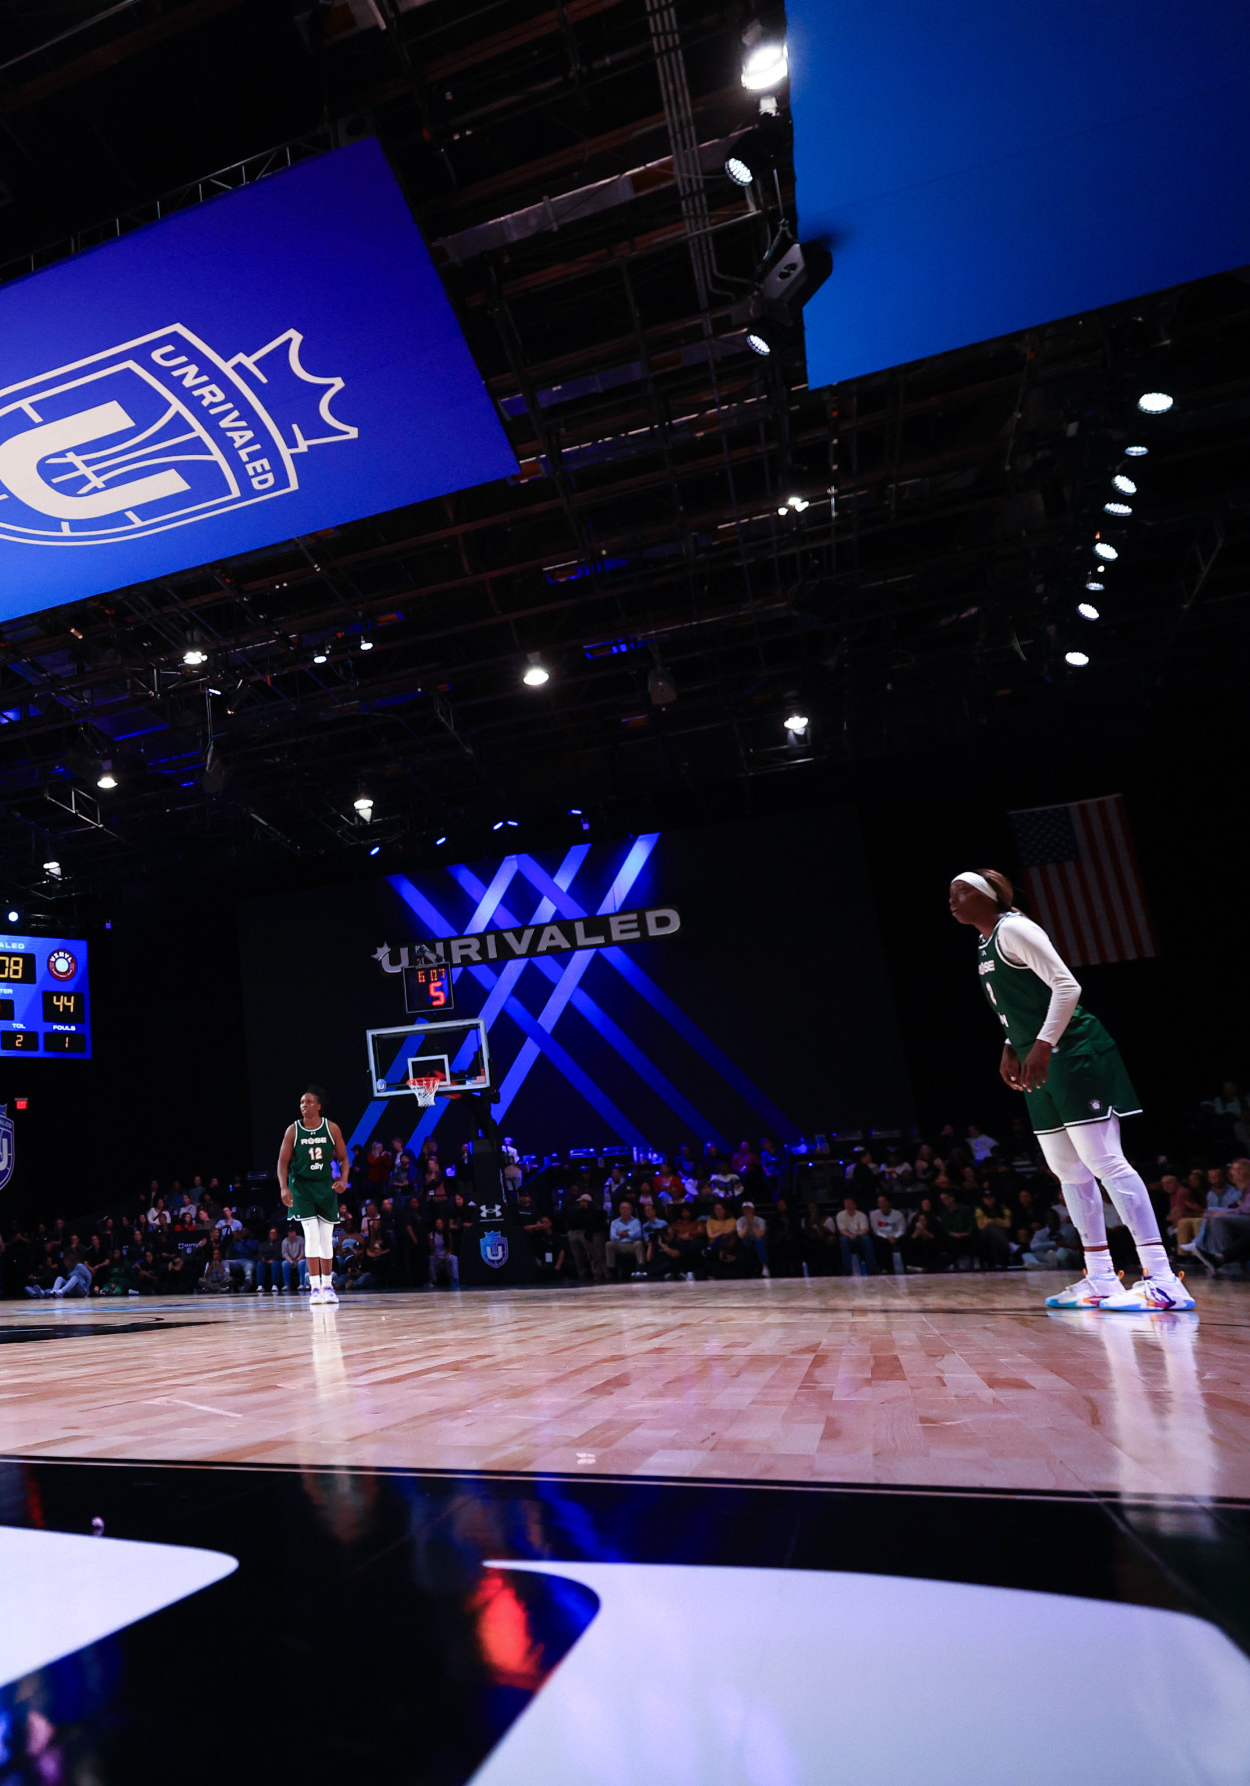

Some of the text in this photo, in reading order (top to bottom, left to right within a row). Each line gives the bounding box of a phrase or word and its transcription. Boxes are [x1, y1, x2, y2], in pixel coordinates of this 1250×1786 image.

[150, 344, 275, 491] UNRIVALED
[380, 908, 681, 973] UNRIVALED
[429, 981, 446, 1006] 5
[53, 995, 75, 1013] 44
[15, 1035, 23, 1047] 2
[300, 1136, 328, 1145] ROSE
[308, 1146, 323, 1161] 12
[310, 1162, 324, 1171] ally
